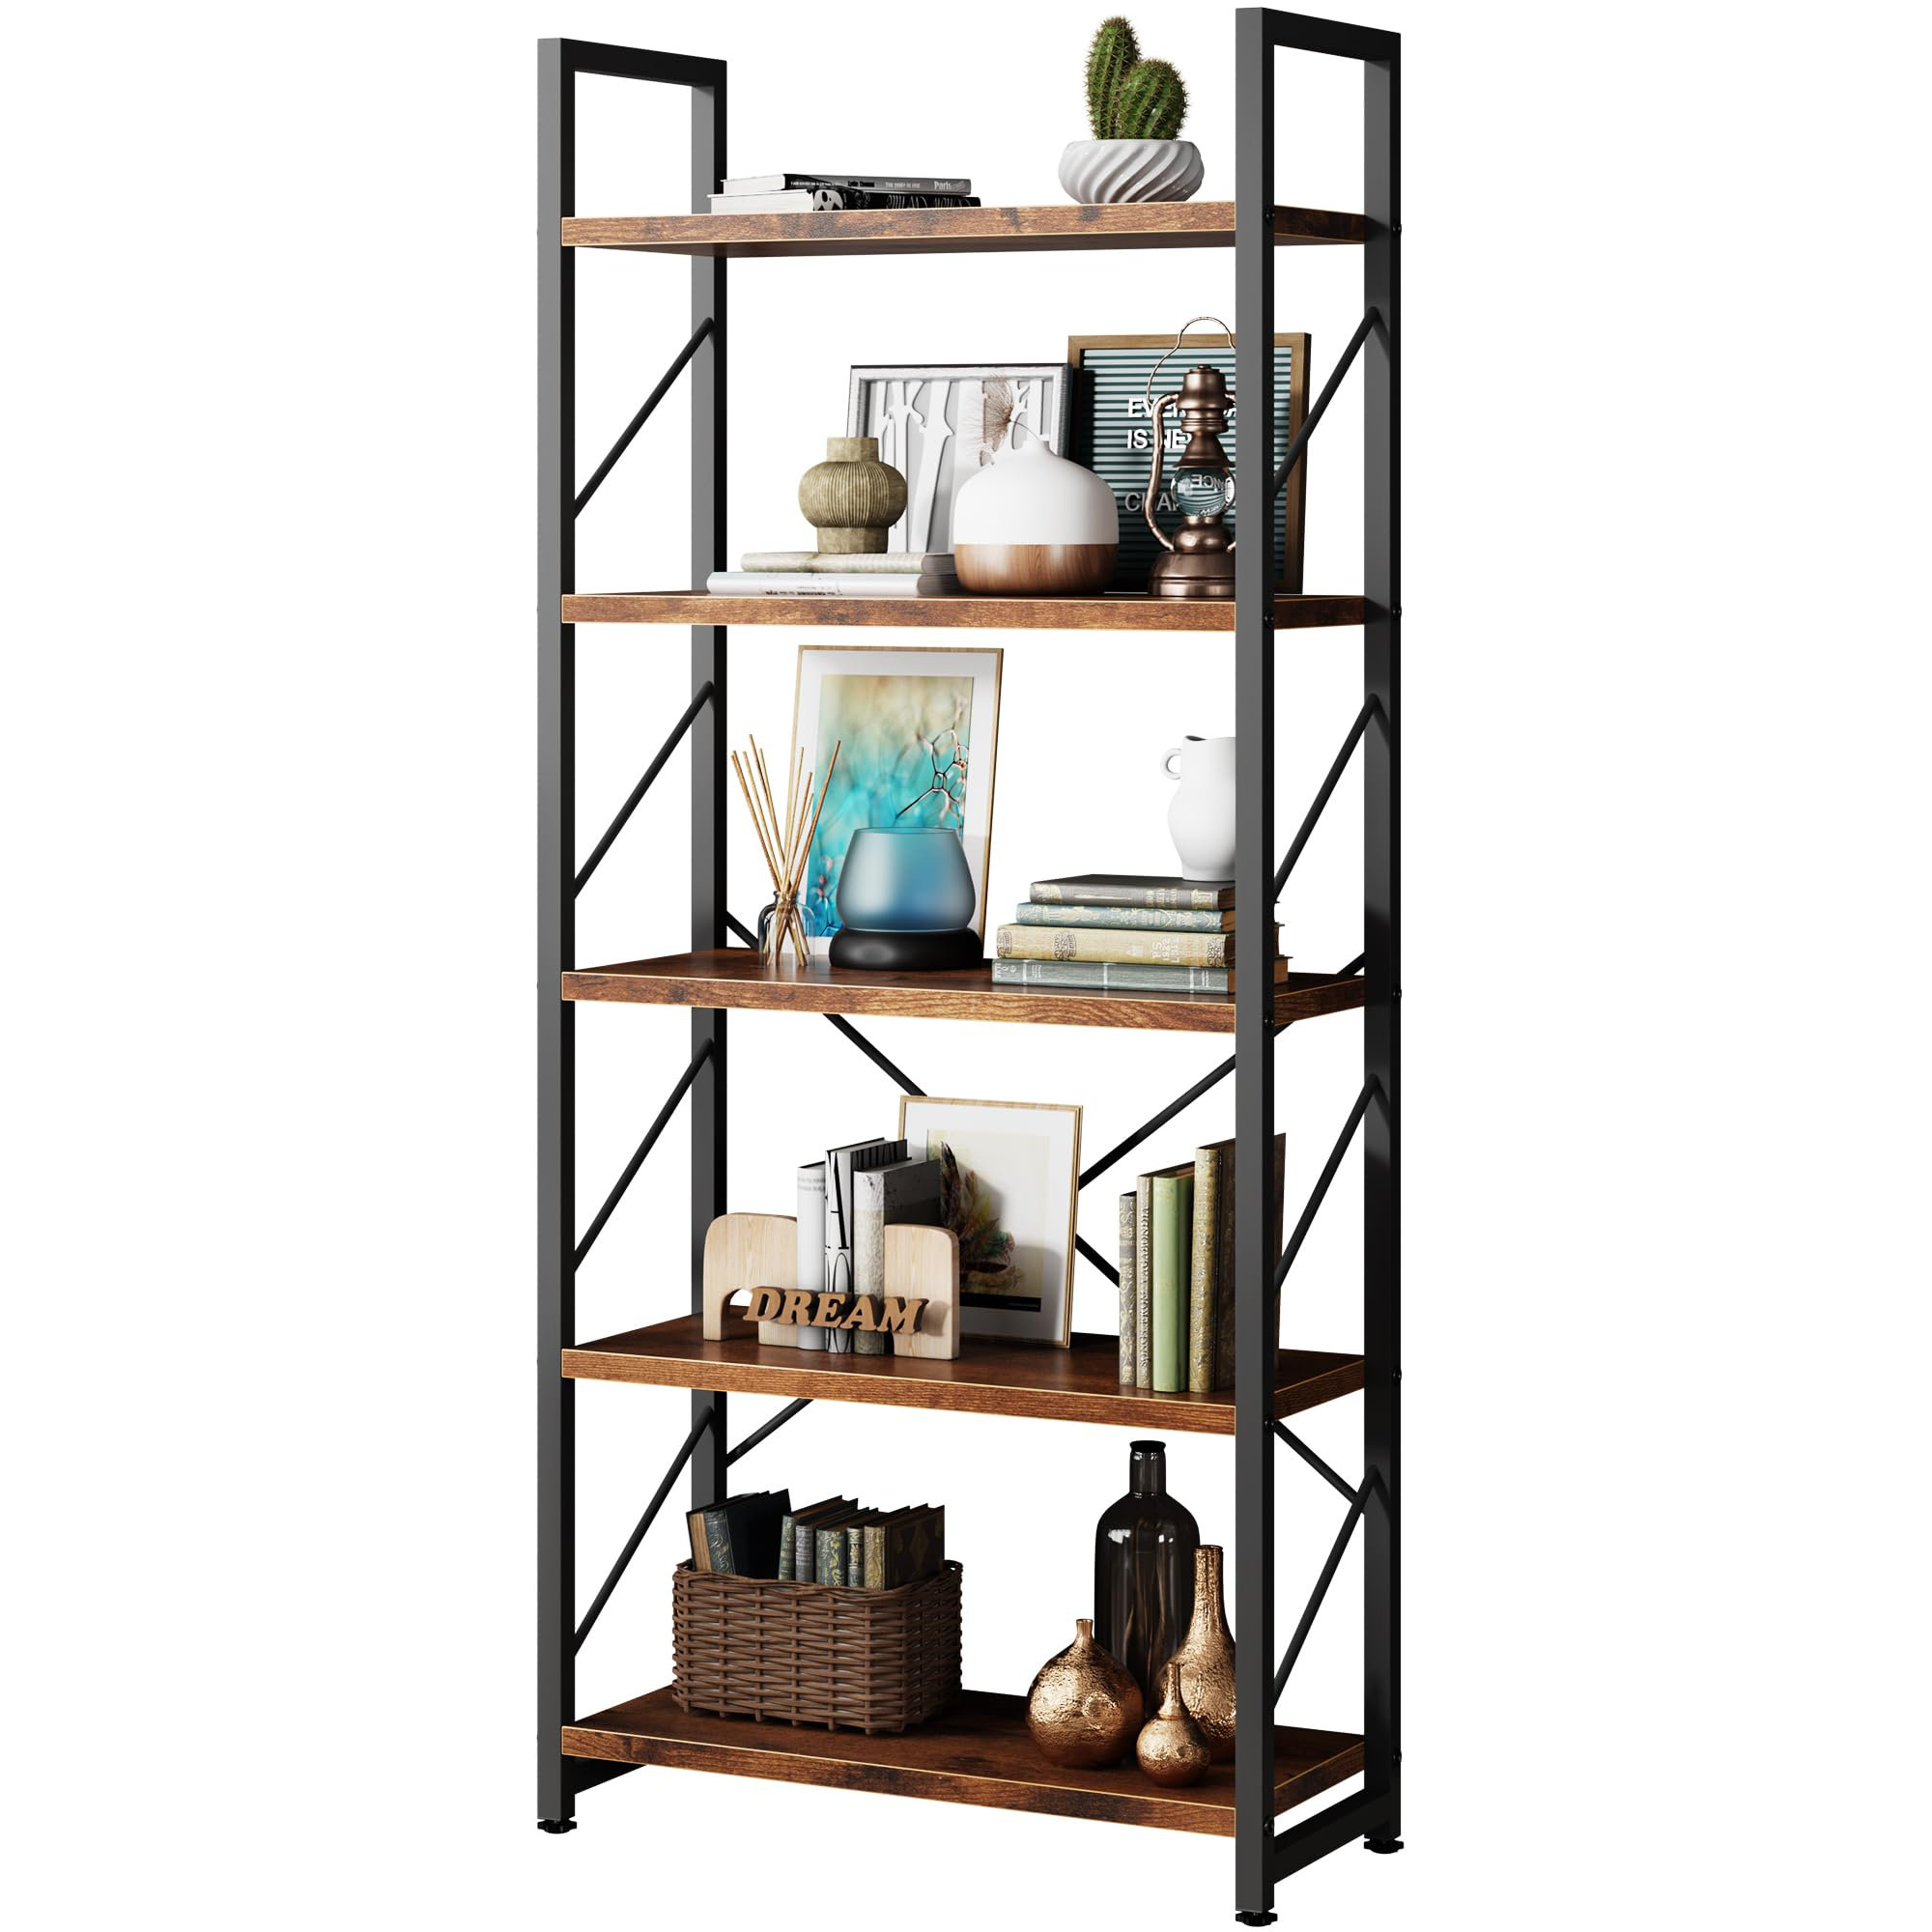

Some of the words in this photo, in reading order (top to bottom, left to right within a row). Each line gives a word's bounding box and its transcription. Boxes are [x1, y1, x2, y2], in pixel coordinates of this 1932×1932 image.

[933, 181, 952, 190] Paris
[1127, 428, 1149, 449] IS
[1162, 428, 1192, 449] NE
[742, 1286, 929, 1334] DREAM
